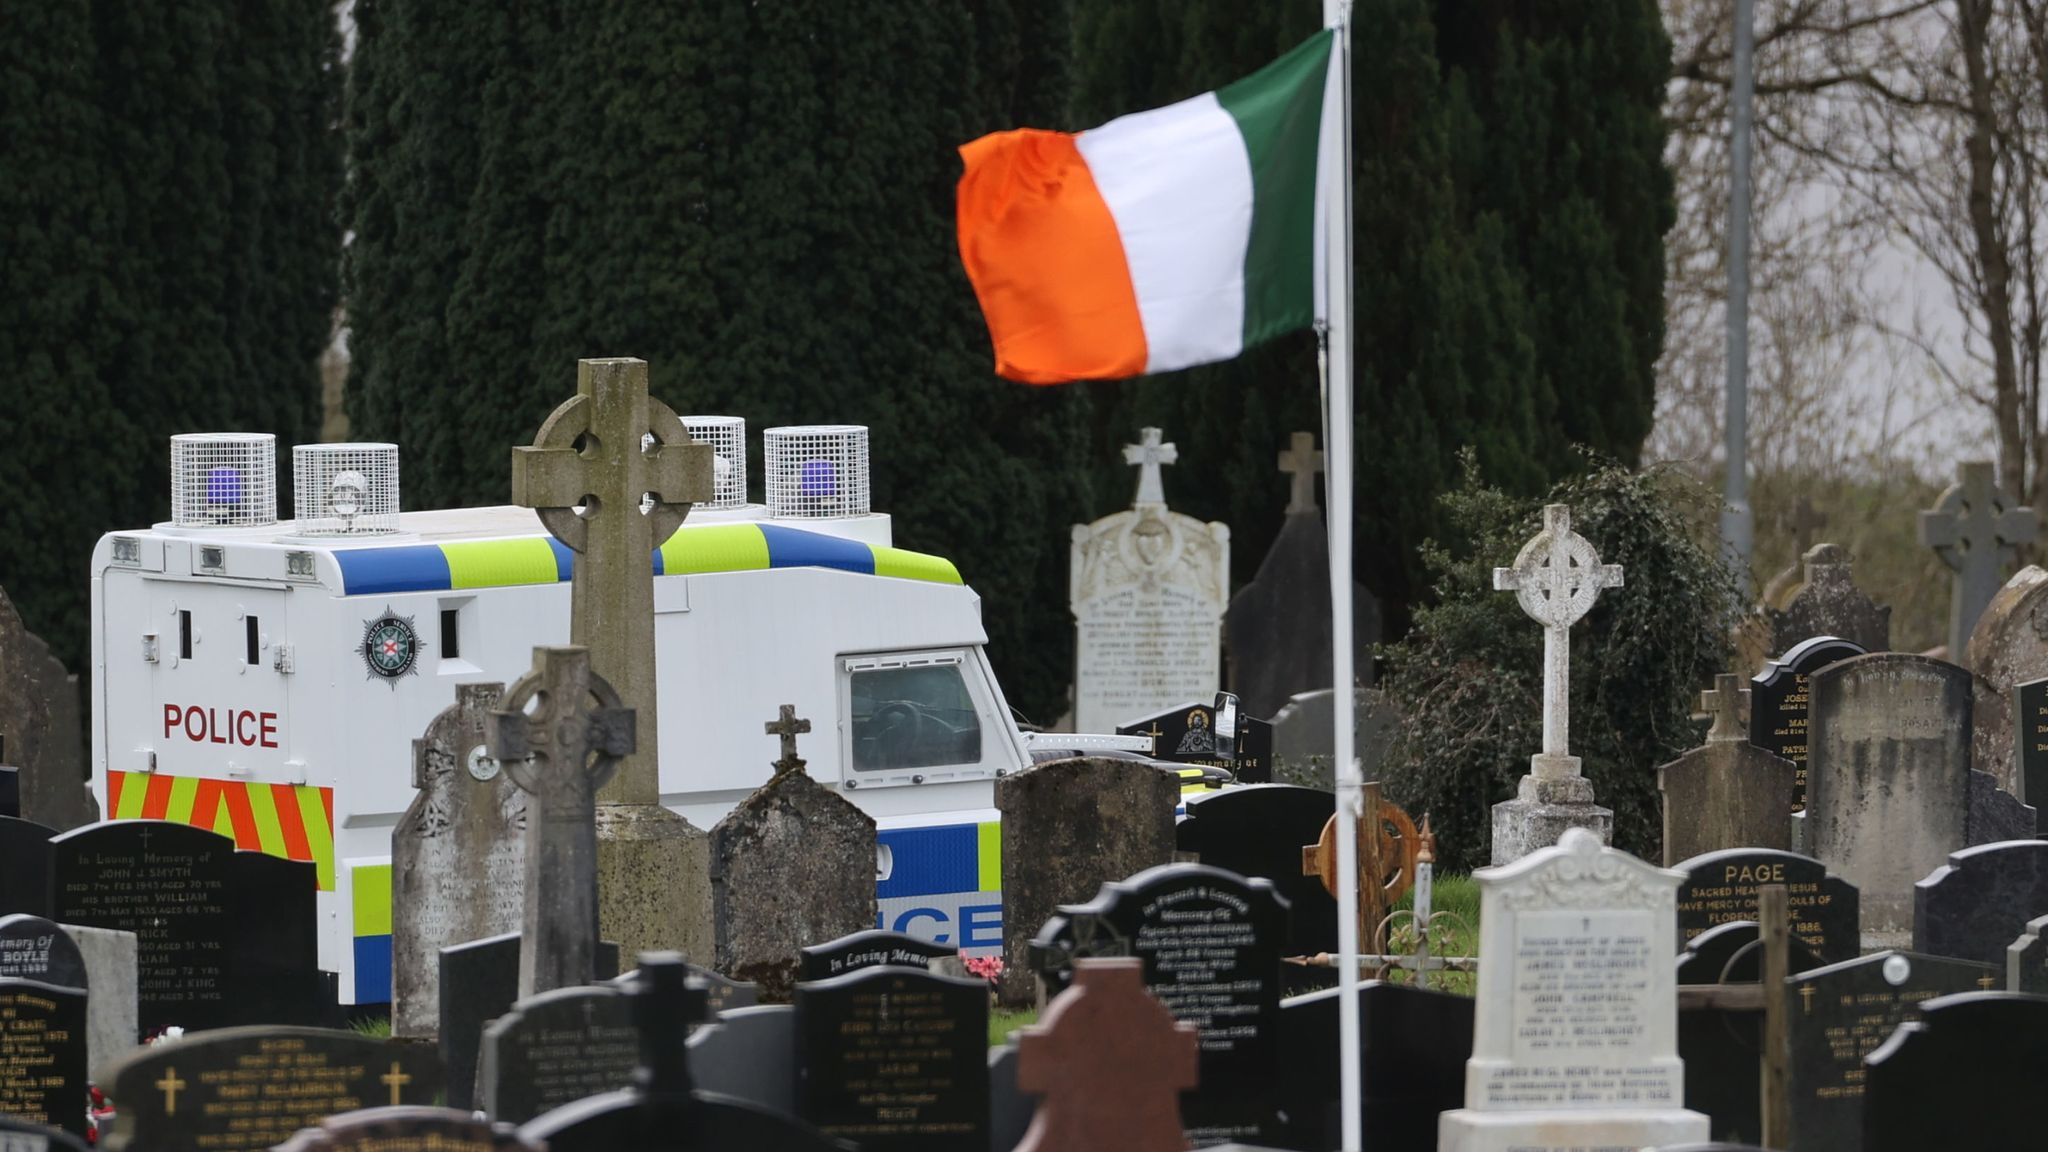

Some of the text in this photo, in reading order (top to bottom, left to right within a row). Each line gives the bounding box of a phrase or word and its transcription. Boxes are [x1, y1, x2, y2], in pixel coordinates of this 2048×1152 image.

[163, 703, 279, 749] POLICE
[99, 868, 131, 880] JOHN
[149, 866, 192, 879] SMYTH
[1725, 863, 1785, 883] PAGE
[155, 892, 208, 903] WILLIAM
[1691, 885, 1732, 899] SACRED
[1706, 899, 1740, 911] MERCY
[1787, 895, 1817, 907] OULS
[877, 904, 1003, 949] CE
[4, 950, 49, 964] BOYLE
[830, 957, 843, 974] In
[845, 948, 887, 968] Loving
